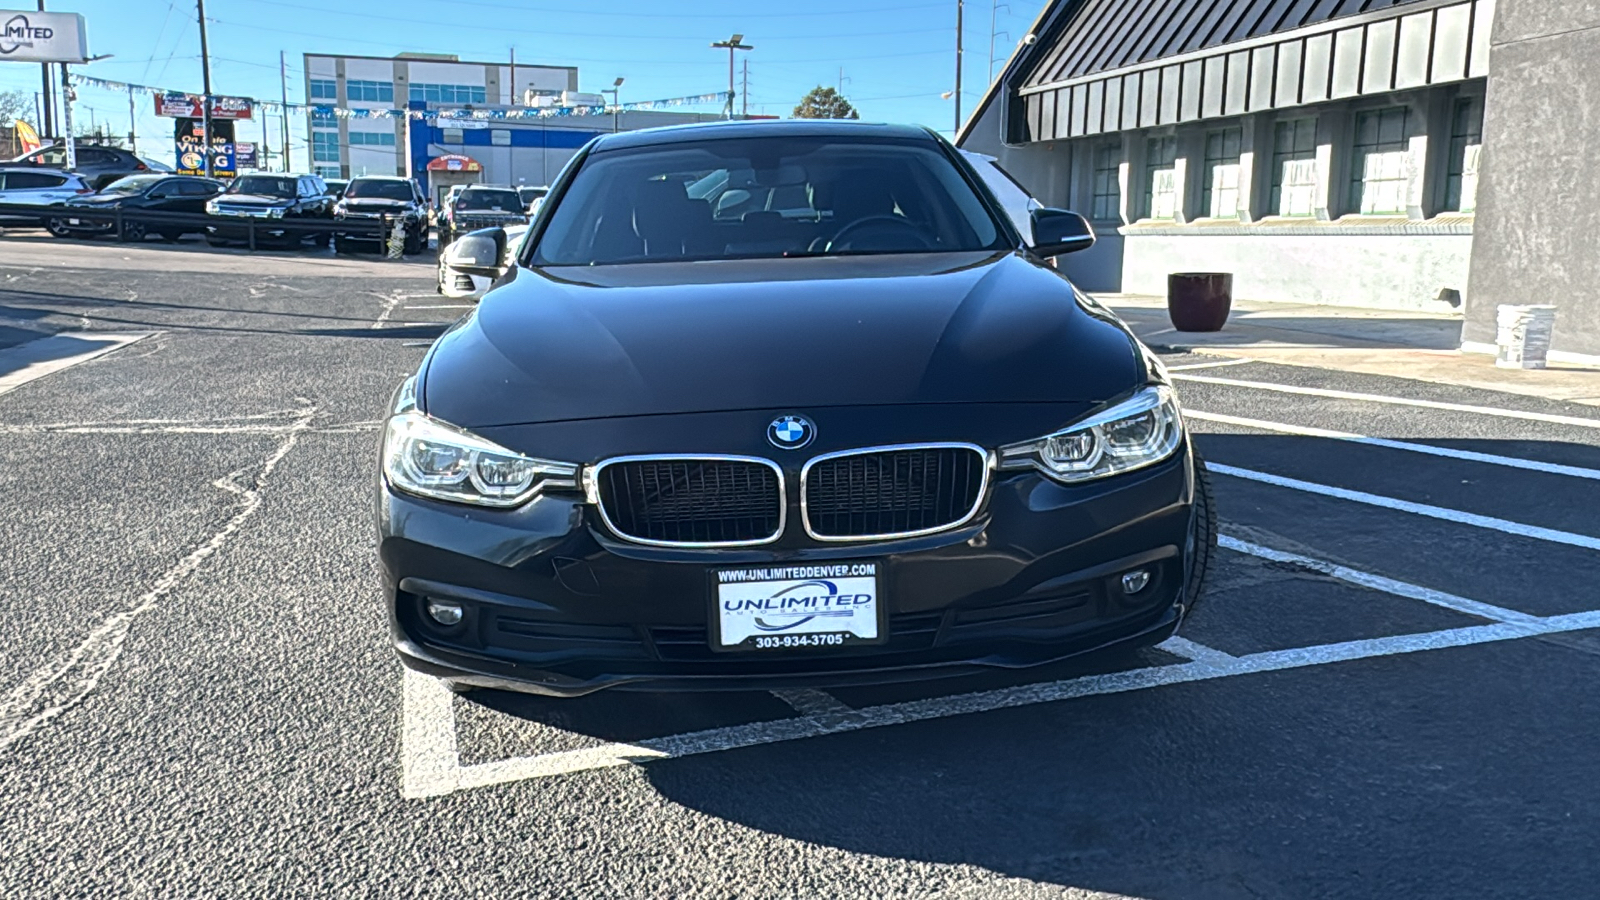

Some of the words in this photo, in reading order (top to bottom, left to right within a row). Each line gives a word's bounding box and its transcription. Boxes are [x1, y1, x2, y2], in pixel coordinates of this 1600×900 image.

[182, 135, 198, 143] On
[177, 142, 233, 155] VIKNG
[440, 154, 469, 162] ENTRANCE
[718, 564, 875, 582] WWW.UNLIMITEDDENVER.COM
[724, 594, 872, 611] UNLIMITED
[780, 605, 832, 613] SALES
[756, 634, 843, 648] 303-934-3705
